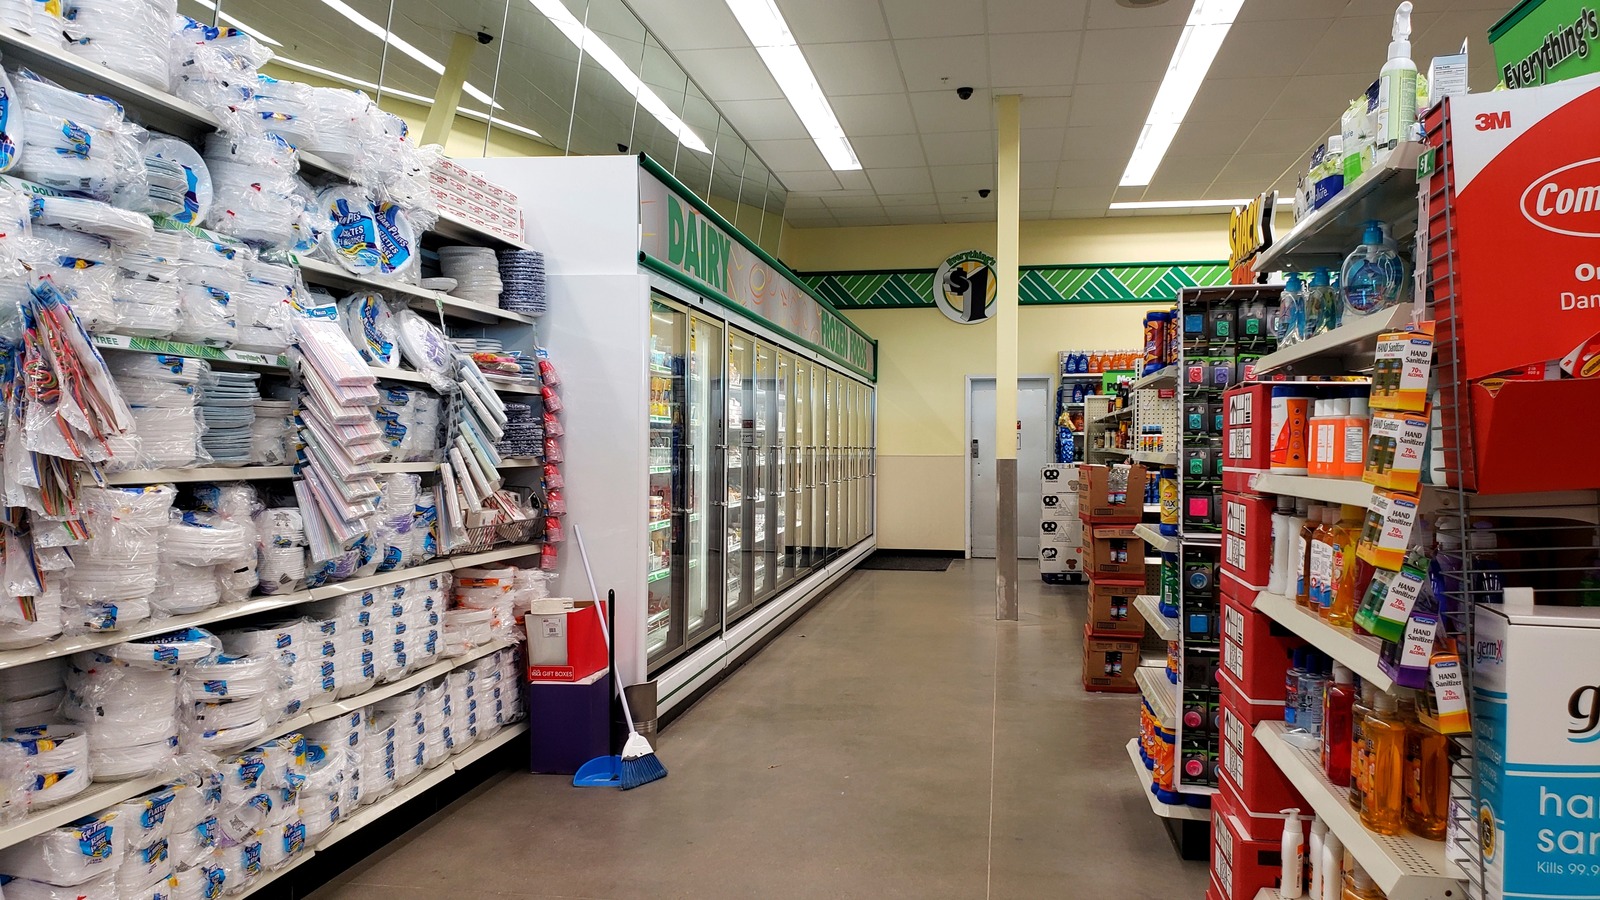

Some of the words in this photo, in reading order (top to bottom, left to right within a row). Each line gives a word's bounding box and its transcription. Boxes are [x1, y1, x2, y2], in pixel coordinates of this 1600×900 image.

[1503, 8, 1599, 89] Everything's
[1475, 111, 1512, 131] 3M
[1229, 195, 1261, 271] SNACK
[668, 194, 731, 293] DAIRY
[946, 250, 996, 266] Everything's
[1574, 263, 1600, 282] O
[942, 264, 988, 322] $1
[94, 336, 118, 346] TREE
[822, 309, 848, 360] FROZEN
[850, 330, 867, 370] FOODS
[1405, 356, 1430, 365] Sanitizer
[1404, 431, 1422, 439] HAND
[1399, 437, 1424, 446] Sanitizer
[1392, 510, 1410, 520] HAND
[1386, 516, 1412, 527] Sanitizer
[1392, 527, 1402, 535] 70%
[1398, 582, 1416, 593] HAND
[1391, 587, 1416, 601] Sanitizer
[1395, 598, 1405, 607] 70%
[1413, 628, 1431, 637] HAND
[1408, 634, 1434, 644] Sanitizer
[1539, 786, 1600, 818] ha
[1537, 861, 1564, 874] Kills
